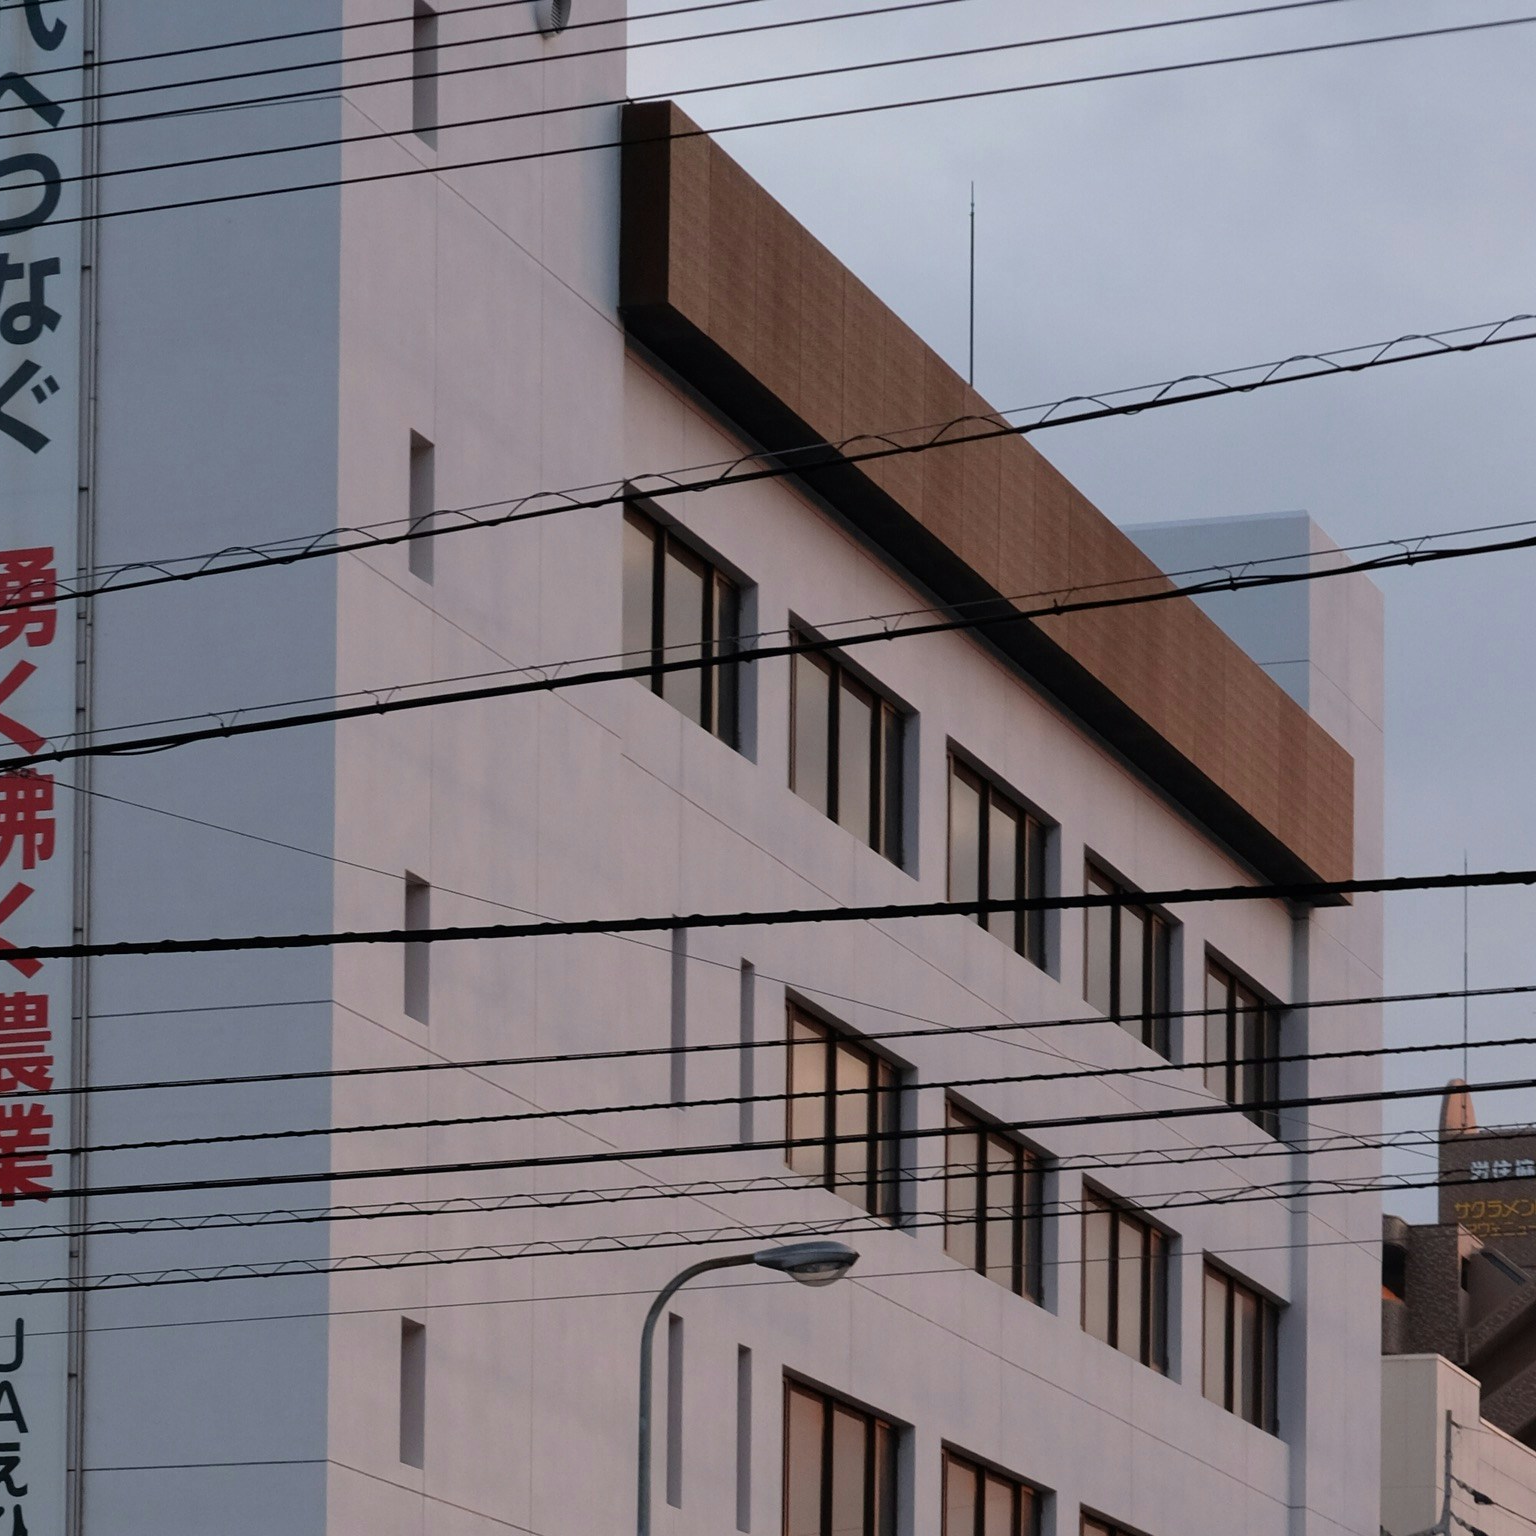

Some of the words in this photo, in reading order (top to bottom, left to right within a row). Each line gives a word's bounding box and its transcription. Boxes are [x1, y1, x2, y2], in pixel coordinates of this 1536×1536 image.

[1454, 1199, 1536, 1219] サクラメン
